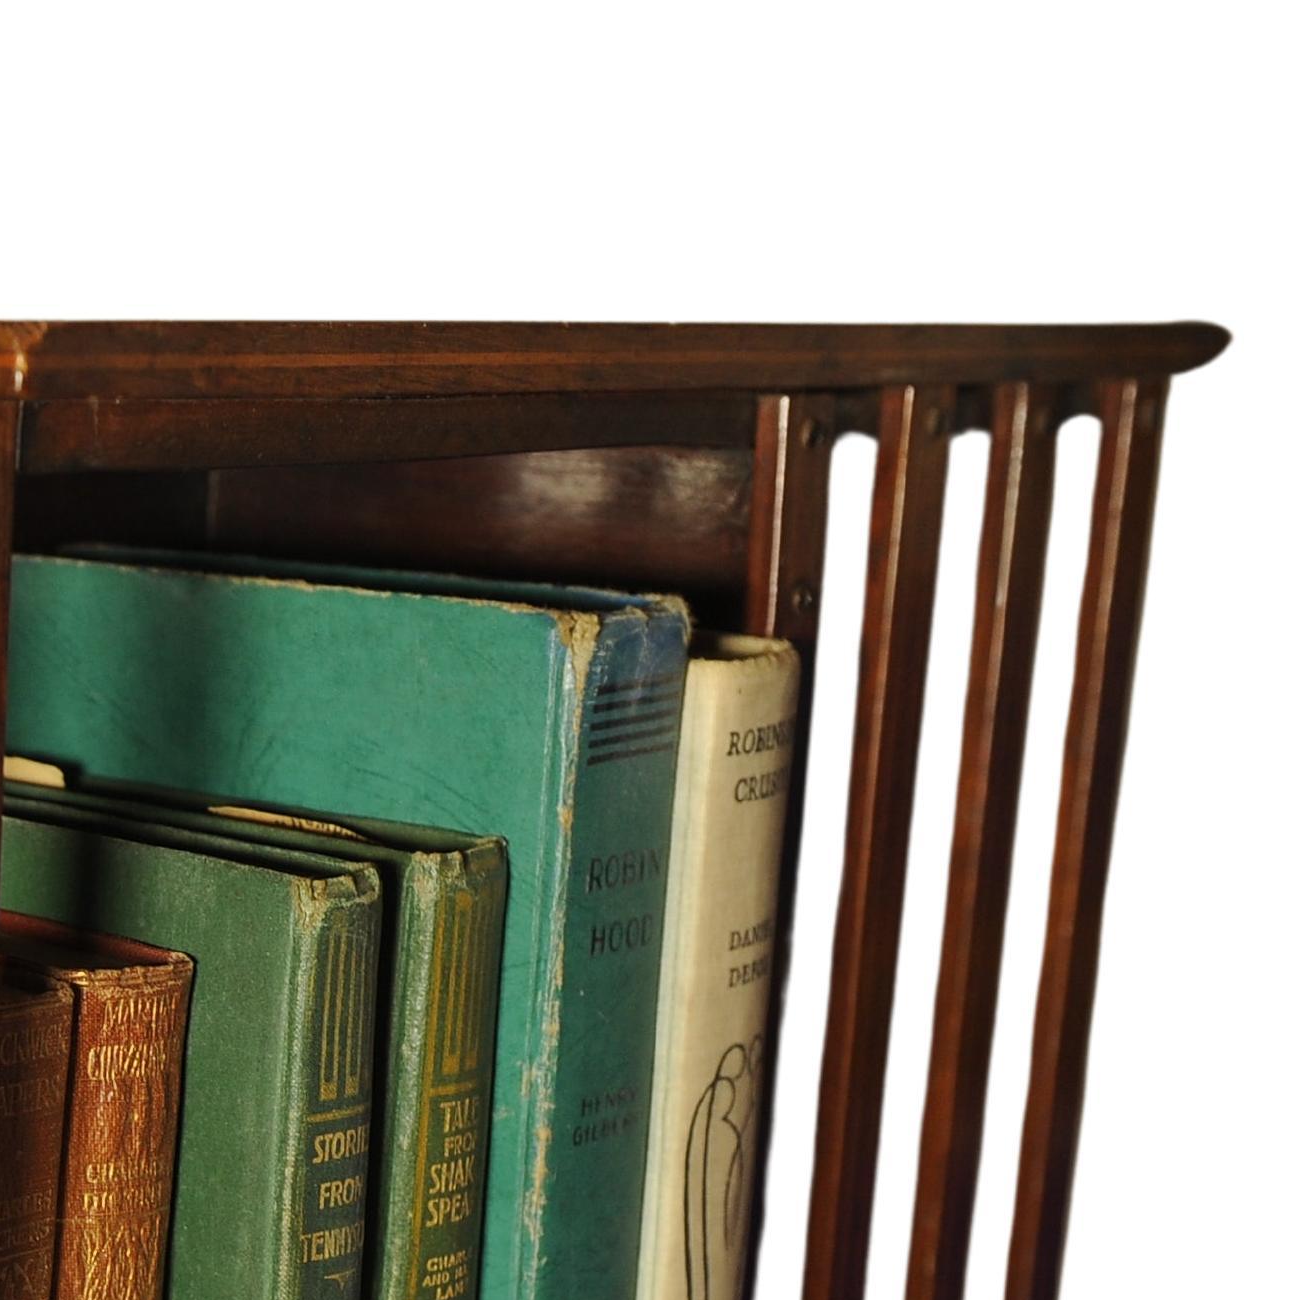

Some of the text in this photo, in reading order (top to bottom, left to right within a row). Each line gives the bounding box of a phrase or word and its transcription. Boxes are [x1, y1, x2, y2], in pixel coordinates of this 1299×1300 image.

[586, 848, 661, 893] ROBIN
[589, 914, 653, 956] HOOD
[429, 1154, 475, 1195] SHAK
[425, 1195, 471, 1228] SPEA
[422, 1270, 450, 1287] AND
